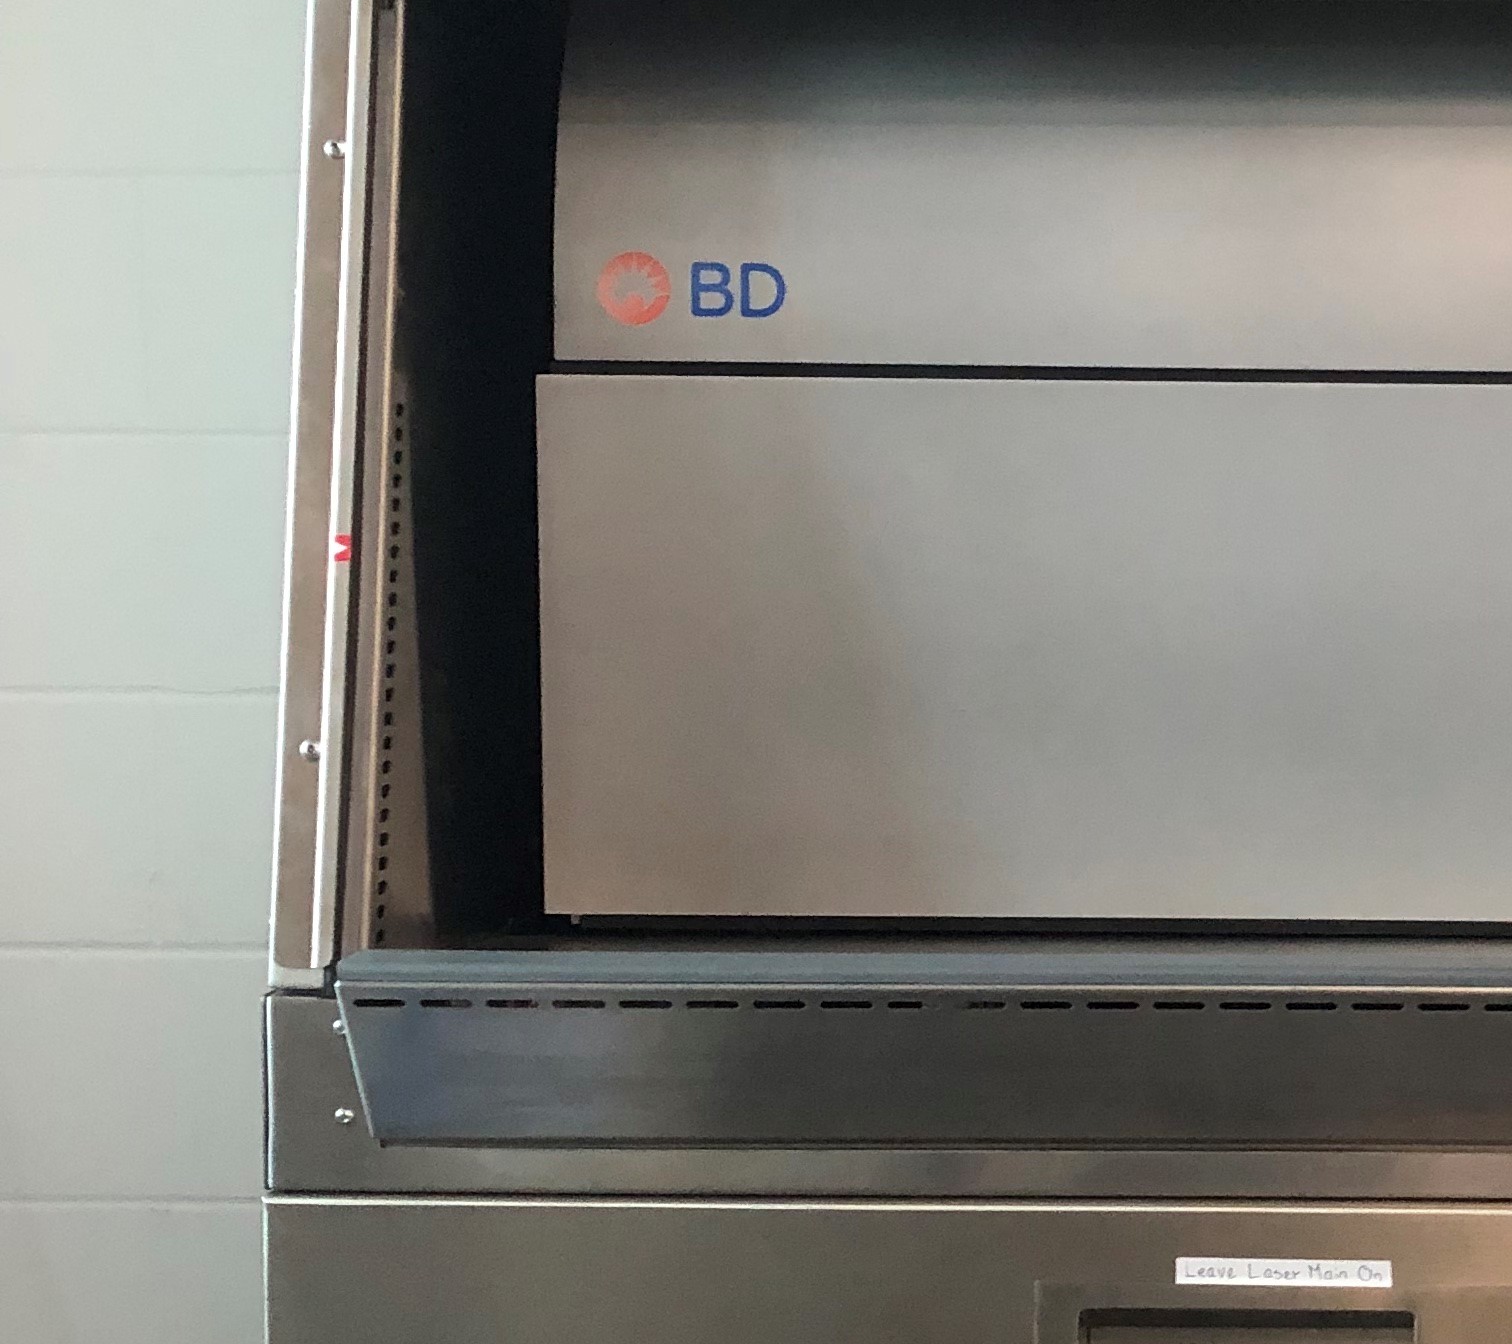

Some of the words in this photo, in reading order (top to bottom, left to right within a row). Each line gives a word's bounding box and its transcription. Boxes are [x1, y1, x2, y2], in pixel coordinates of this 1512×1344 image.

[690, 261, 787, 318] BD
[1184, 1263, 1237, 1279] Leave
[1248, 1263, 1301, 1280] Laser
[1307, 1264, 1349, 1280] Main
[1357, 1265, 1384, 1282] On
